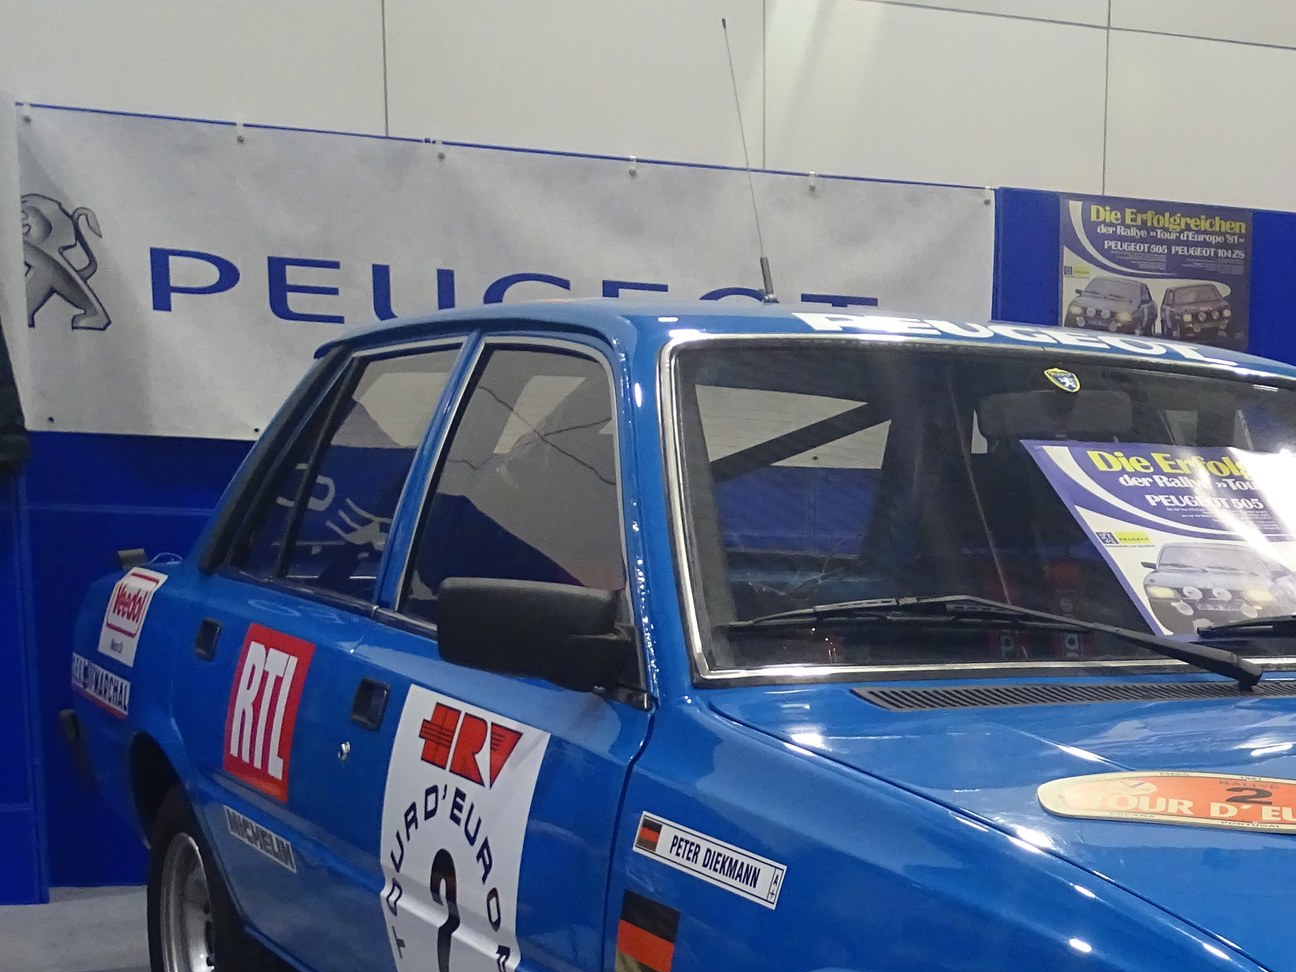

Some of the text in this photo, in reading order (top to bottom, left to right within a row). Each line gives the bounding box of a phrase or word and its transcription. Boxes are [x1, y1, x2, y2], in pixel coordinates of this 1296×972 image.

[1090, 204, 1246, 233] Die Erfolgreichen
[1097, 224, 1116, 235] der
[1117, 226, 1147, 238] Rallye
[1104, 240, 1168, 254] PEUGEOT 505
[1171, 246, 1216, 257] PEUGEOT
[150, 246, 880, 325] PEUG
[793, 312, 1238, 367] PEUGEOT
[1087, 450, 1155, 473] Die
[1119, 474, 1154, 487] der
[1216, 478, 1257, 491] »Tou
[1232, 498, 1265, 509] 505
[112, 583, 149, 624] Veedol
[94, 667, 128, 711] MARCHAL
[229, 641, 298, 780] RTL
[1225, 787, 1273, 805] 2
[226, 809, 296, 871] MICHELIN
[669, 834, 761, 889] PETER DIEKMANN
